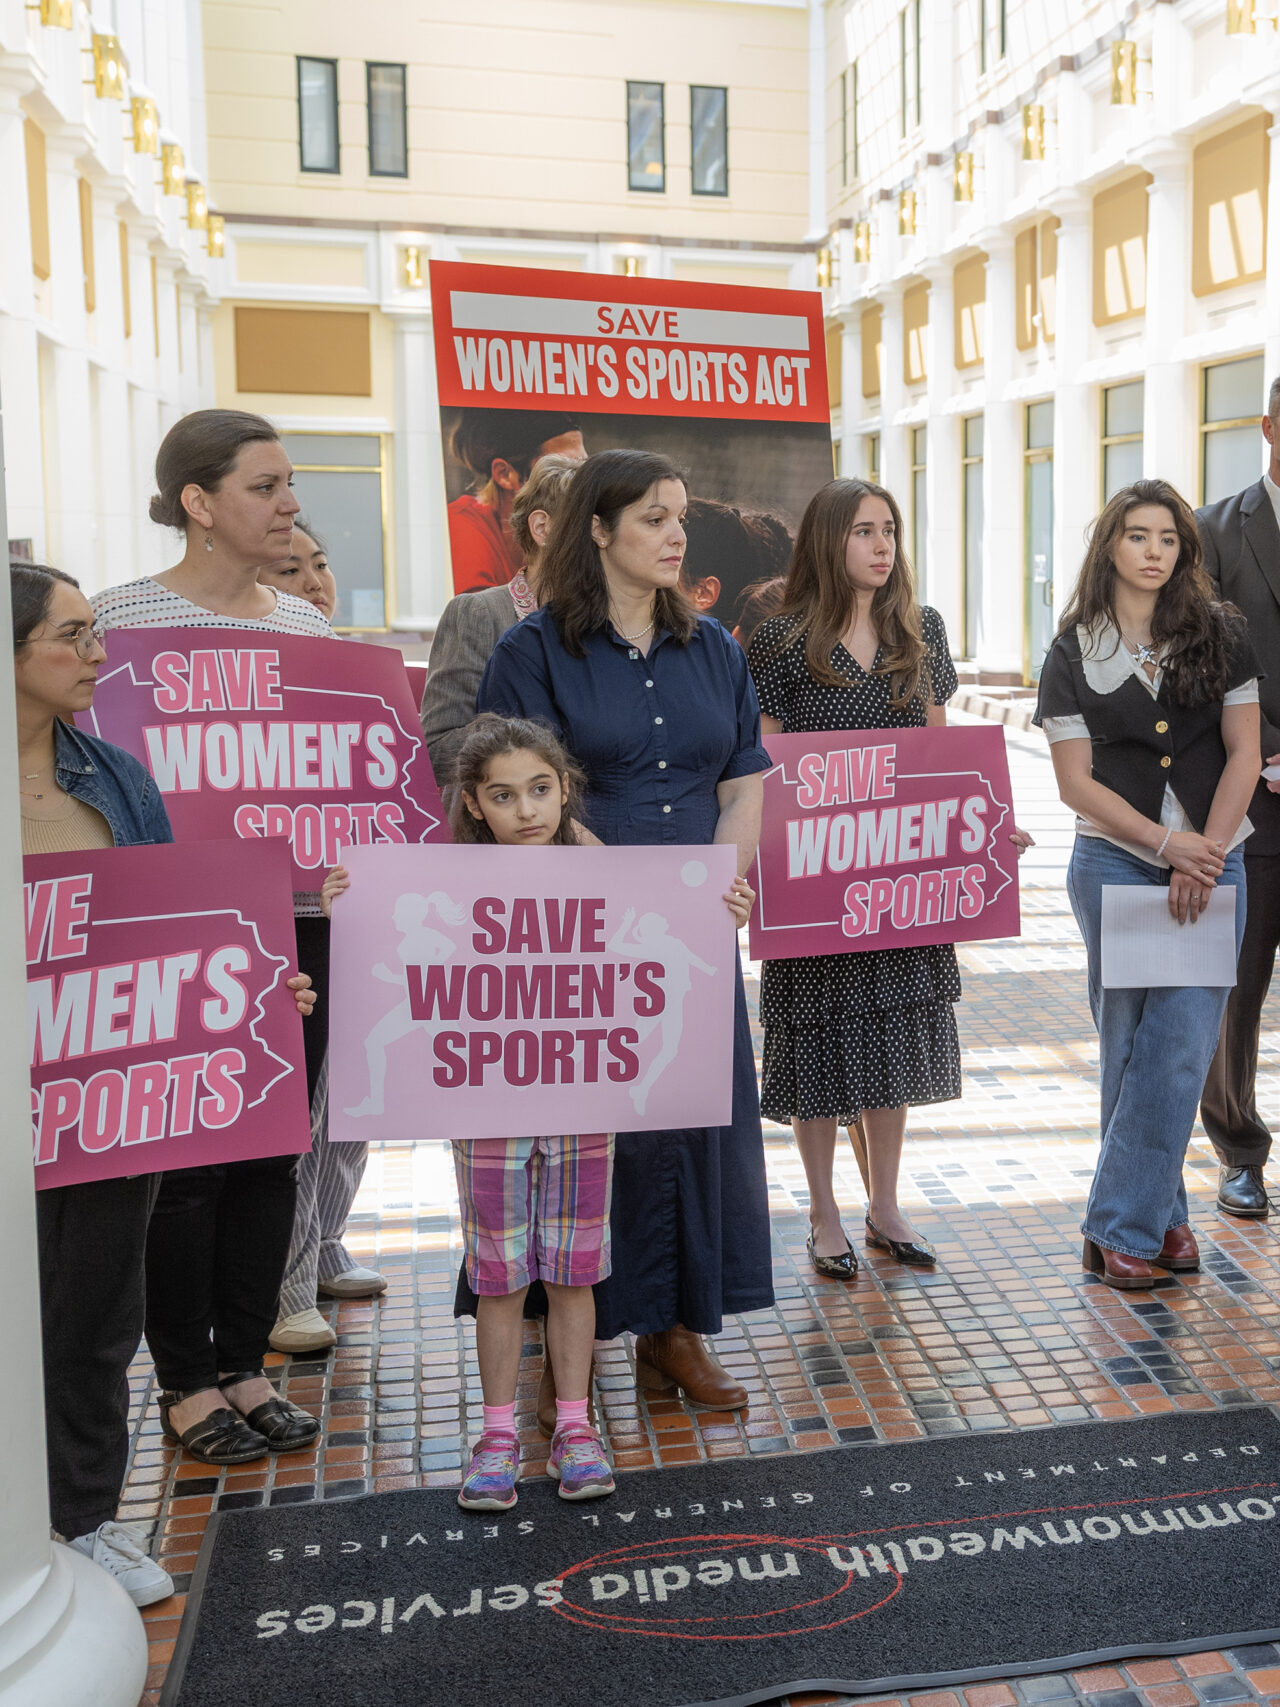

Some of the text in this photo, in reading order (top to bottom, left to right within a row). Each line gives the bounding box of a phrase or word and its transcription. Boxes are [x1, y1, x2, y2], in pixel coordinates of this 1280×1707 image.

[597, 306, 679, 338] SAVE
[453, 336, 810, 406] WOMEN'S SPORTS ACT
[151, 649, 284, 714] SAVE
[142, 721, 398, 794] WOMEN'S
[796, 744, 896, 809] SAVE
[233, 801, 408, 869] SPORTS
[786, 795, 988, 881] WOMEN'S
[23, 873, 93, 966] VE
[472, 896, 606, 955] SAVE
[841, 864, 986, 938] SPORTS
[26, 944, 251, 1067] MEN'S
[406, 961, 666, 1022] WOMEN'S
[433, 1027, 640, 1089] SPORTS
[31, 1048, 246, 1166] PORTS
[267, 1445, 1260, 1561] DEPARTMENT OF GENERAL SERVICES
[256, 1580, 563, 1639] services
[589, 1553, 800, 1603] media
